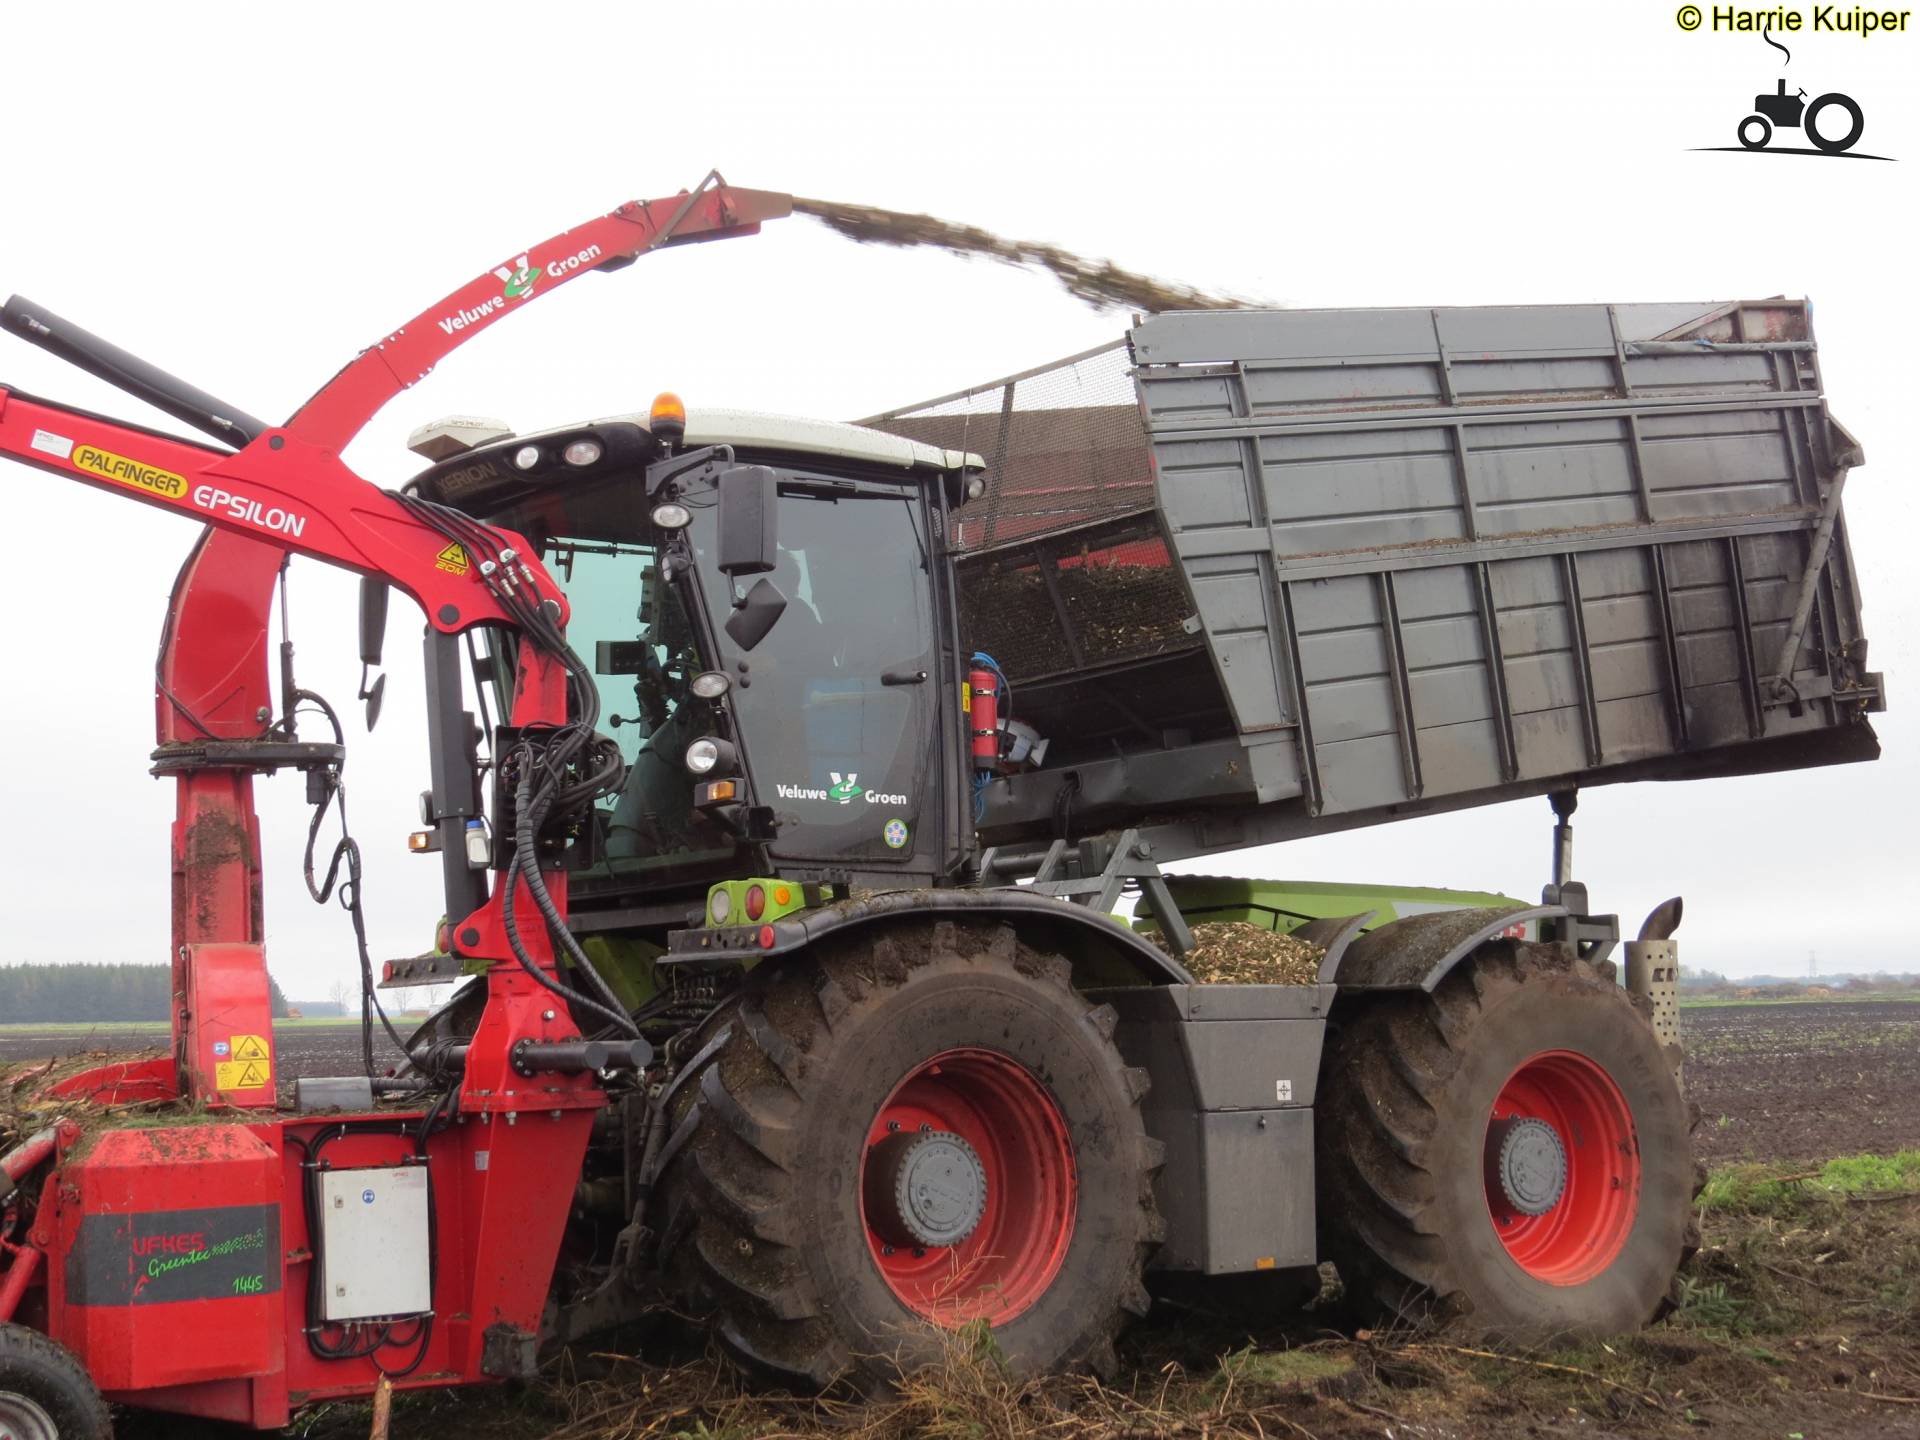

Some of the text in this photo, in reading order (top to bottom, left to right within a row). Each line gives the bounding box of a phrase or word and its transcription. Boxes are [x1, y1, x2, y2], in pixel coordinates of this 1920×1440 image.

[438, 244, 602, 334] Veluwe Groen
[79, 448, 181, 495] PALFINGER
[192, 484, 307, 538] EPSILON
[776, 784, 907, 805] Veluwe Groen
[133, 1232, 206, 1255] UFKES
[232, 1274, 264, 1295] 1445
